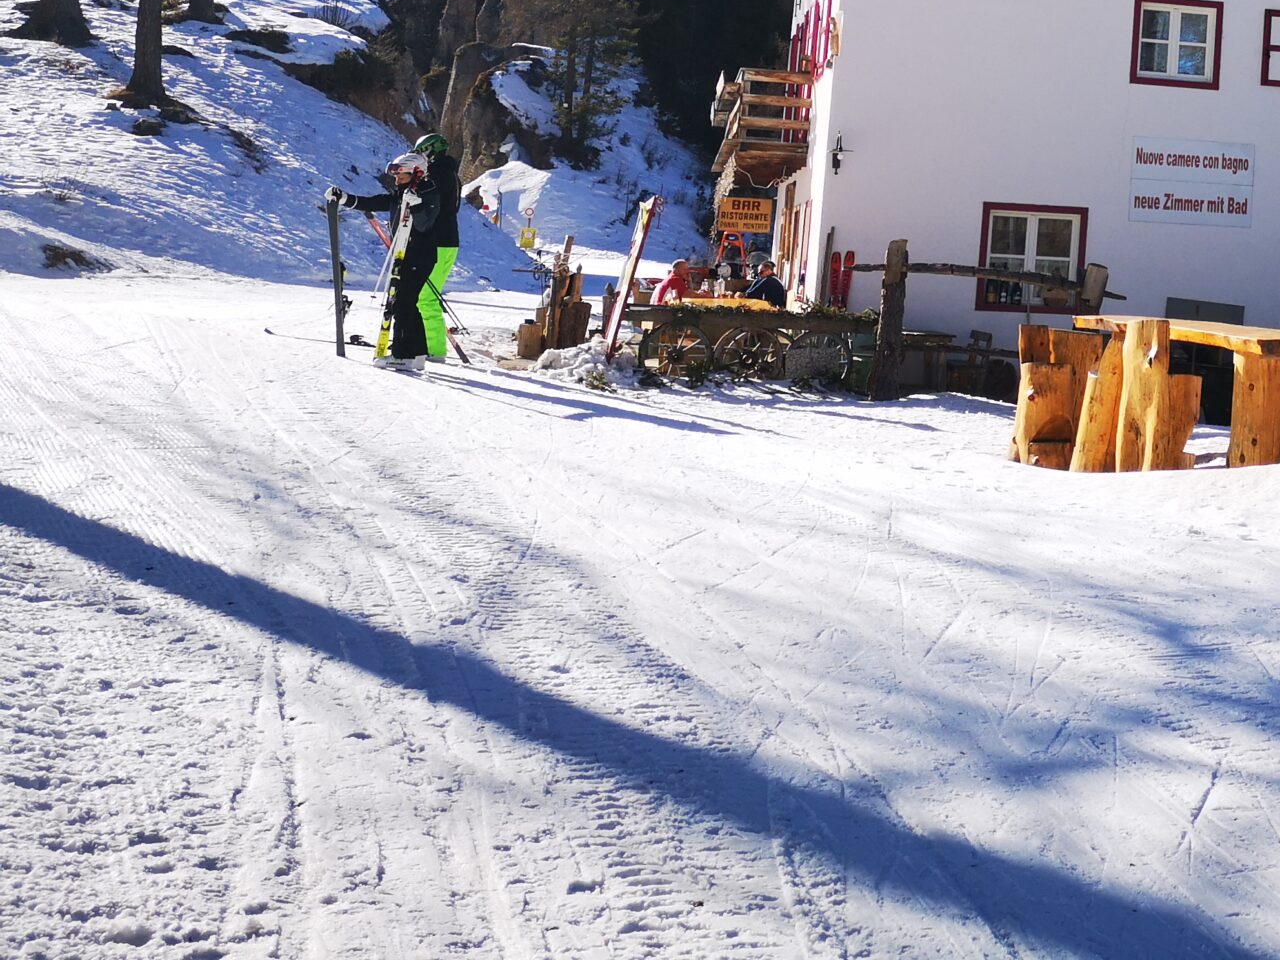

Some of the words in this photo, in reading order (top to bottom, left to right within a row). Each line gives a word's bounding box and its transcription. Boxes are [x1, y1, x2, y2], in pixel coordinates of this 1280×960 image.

[1136, 147, 1164, 166] Nuove
[1166, 153, 1200, 168] camere
[1202, 156, 1219, 169] con
[1221, 153, 1249, 175] bagno
[732, 200, 761, 211] BAR
[1134, 195, 1160, 209] neue
[1163, 193, 1204, 212] Zimmer
[1207, 196, 1225, 213] mit
[1227, 197, 1248, 215] Bad
[721, 211, 769, 222] RISTORANTE
